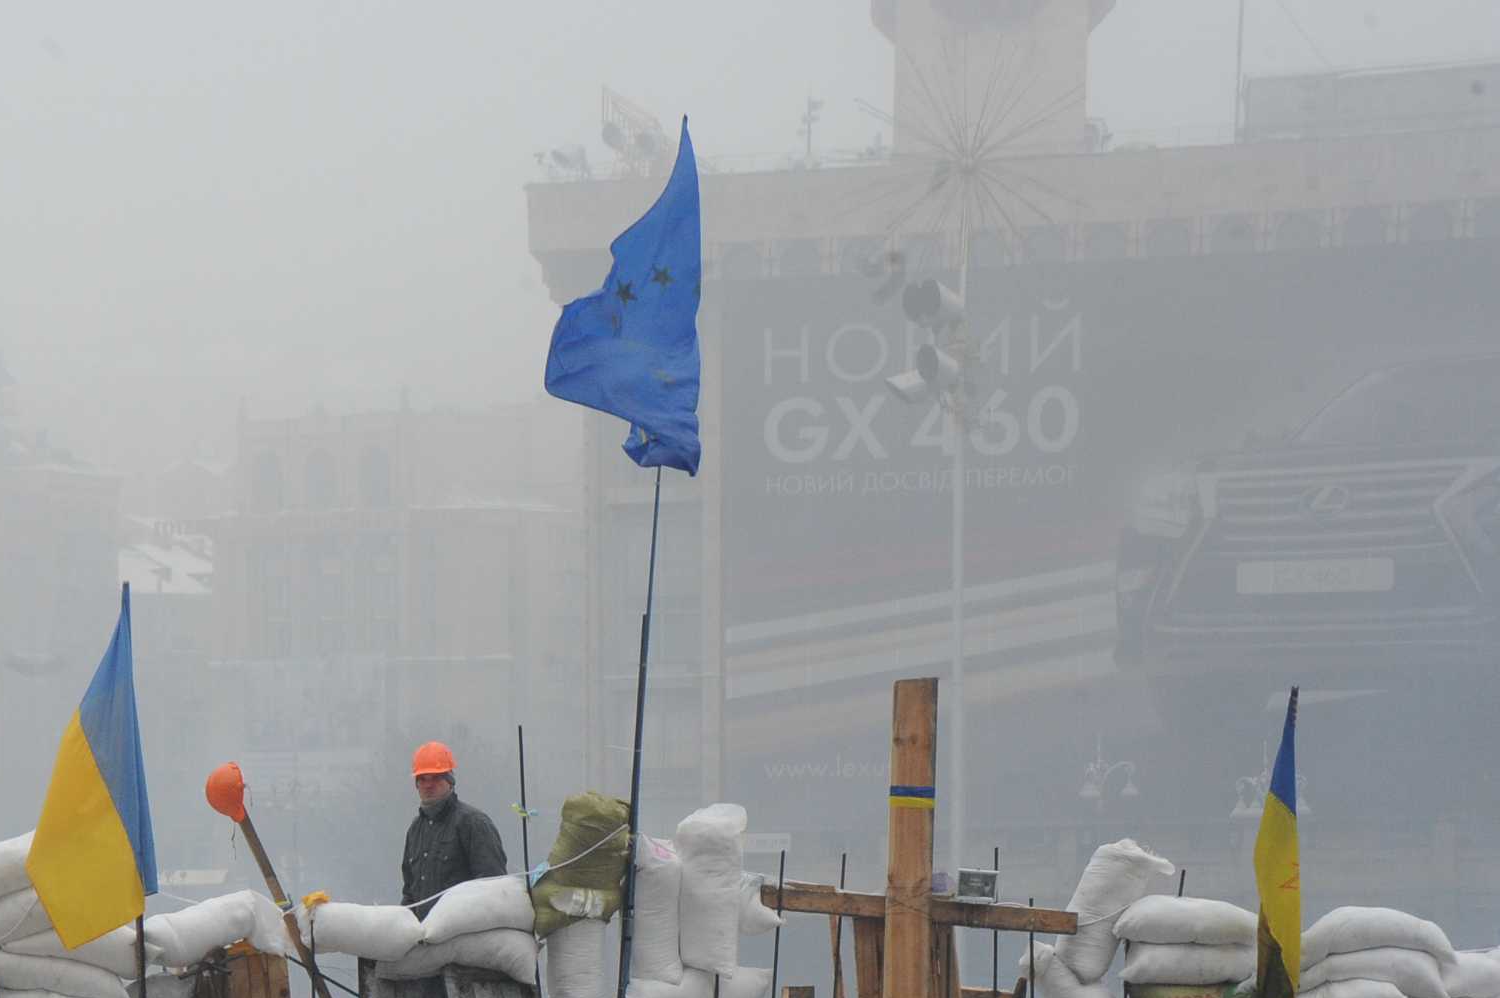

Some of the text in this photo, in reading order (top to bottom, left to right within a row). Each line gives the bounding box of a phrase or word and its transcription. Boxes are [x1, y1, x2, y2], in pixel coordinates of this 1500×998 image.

[763, 386, 1080, 463] GX 460
[764, 470, 854, 495] НОВИЙ
[764, 752, 890, 777] www.lexu
